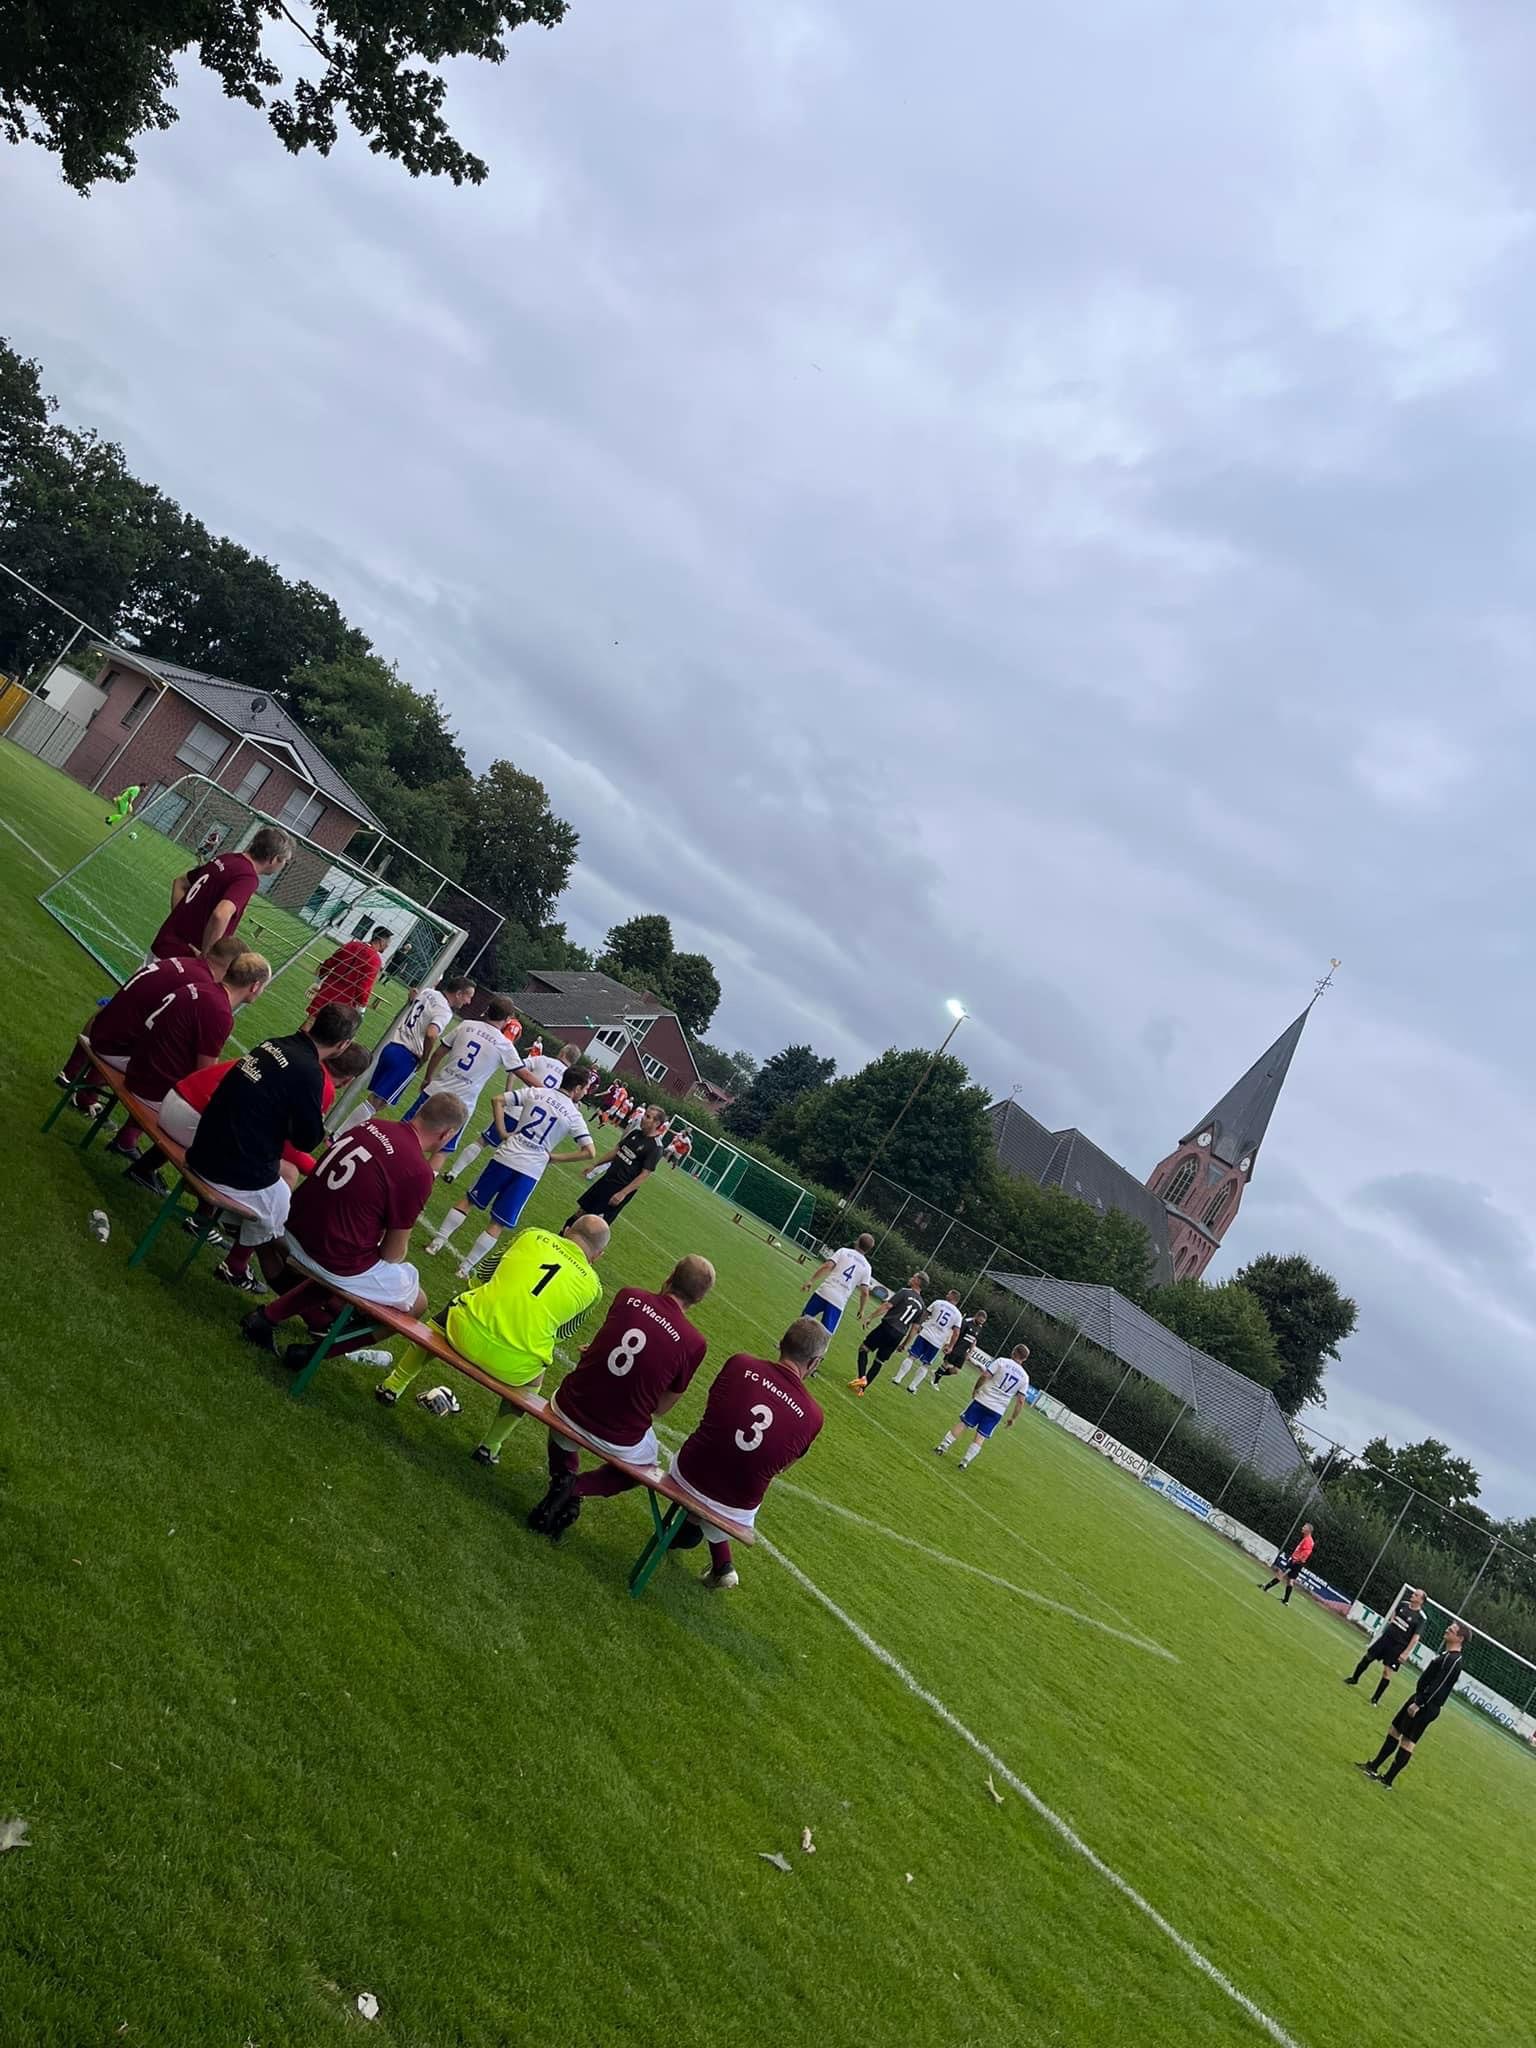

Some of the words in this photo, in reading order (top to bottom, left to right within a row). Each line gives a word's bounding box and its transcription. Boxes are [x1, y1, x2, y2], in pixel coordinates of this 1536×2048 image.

[185, 873, 210, 904] 6
[145, 993, 176, 1031] 2
[404, 999, 424, 1028] 13
[457, 1040, 481, 1071] 3
[546, 1095, 569, 1117] ESSEN
[366, 1123, 395, 1155] Wachtum
[520, 1106, 558, 1145] 21
[315, 1136, 373, 1190] 15
[536, 1235, 550, 1244] FC
[552, 1243, 588, 1277] Wachtum
[531, 1263, 562, 1296] 1
[843, 1264, 856, 1282] 4
[626, 1297, 641, 1308] FC
[641, 1303, 681, 1342] Wachtum
[900, 1304, 918, 1324] 11
[936, 1309, 951, 1327] 15
[607, 1328, 647, 1377] 8
[744, 1370, 760, 1381] FC
[762, 1378, 804, 1418] Wachtum
[998, 1372, 1019, 1393] 17
[735, 1404, 773, 1451] 3
[1103, 1438, 1146, 1474] Imbusch
